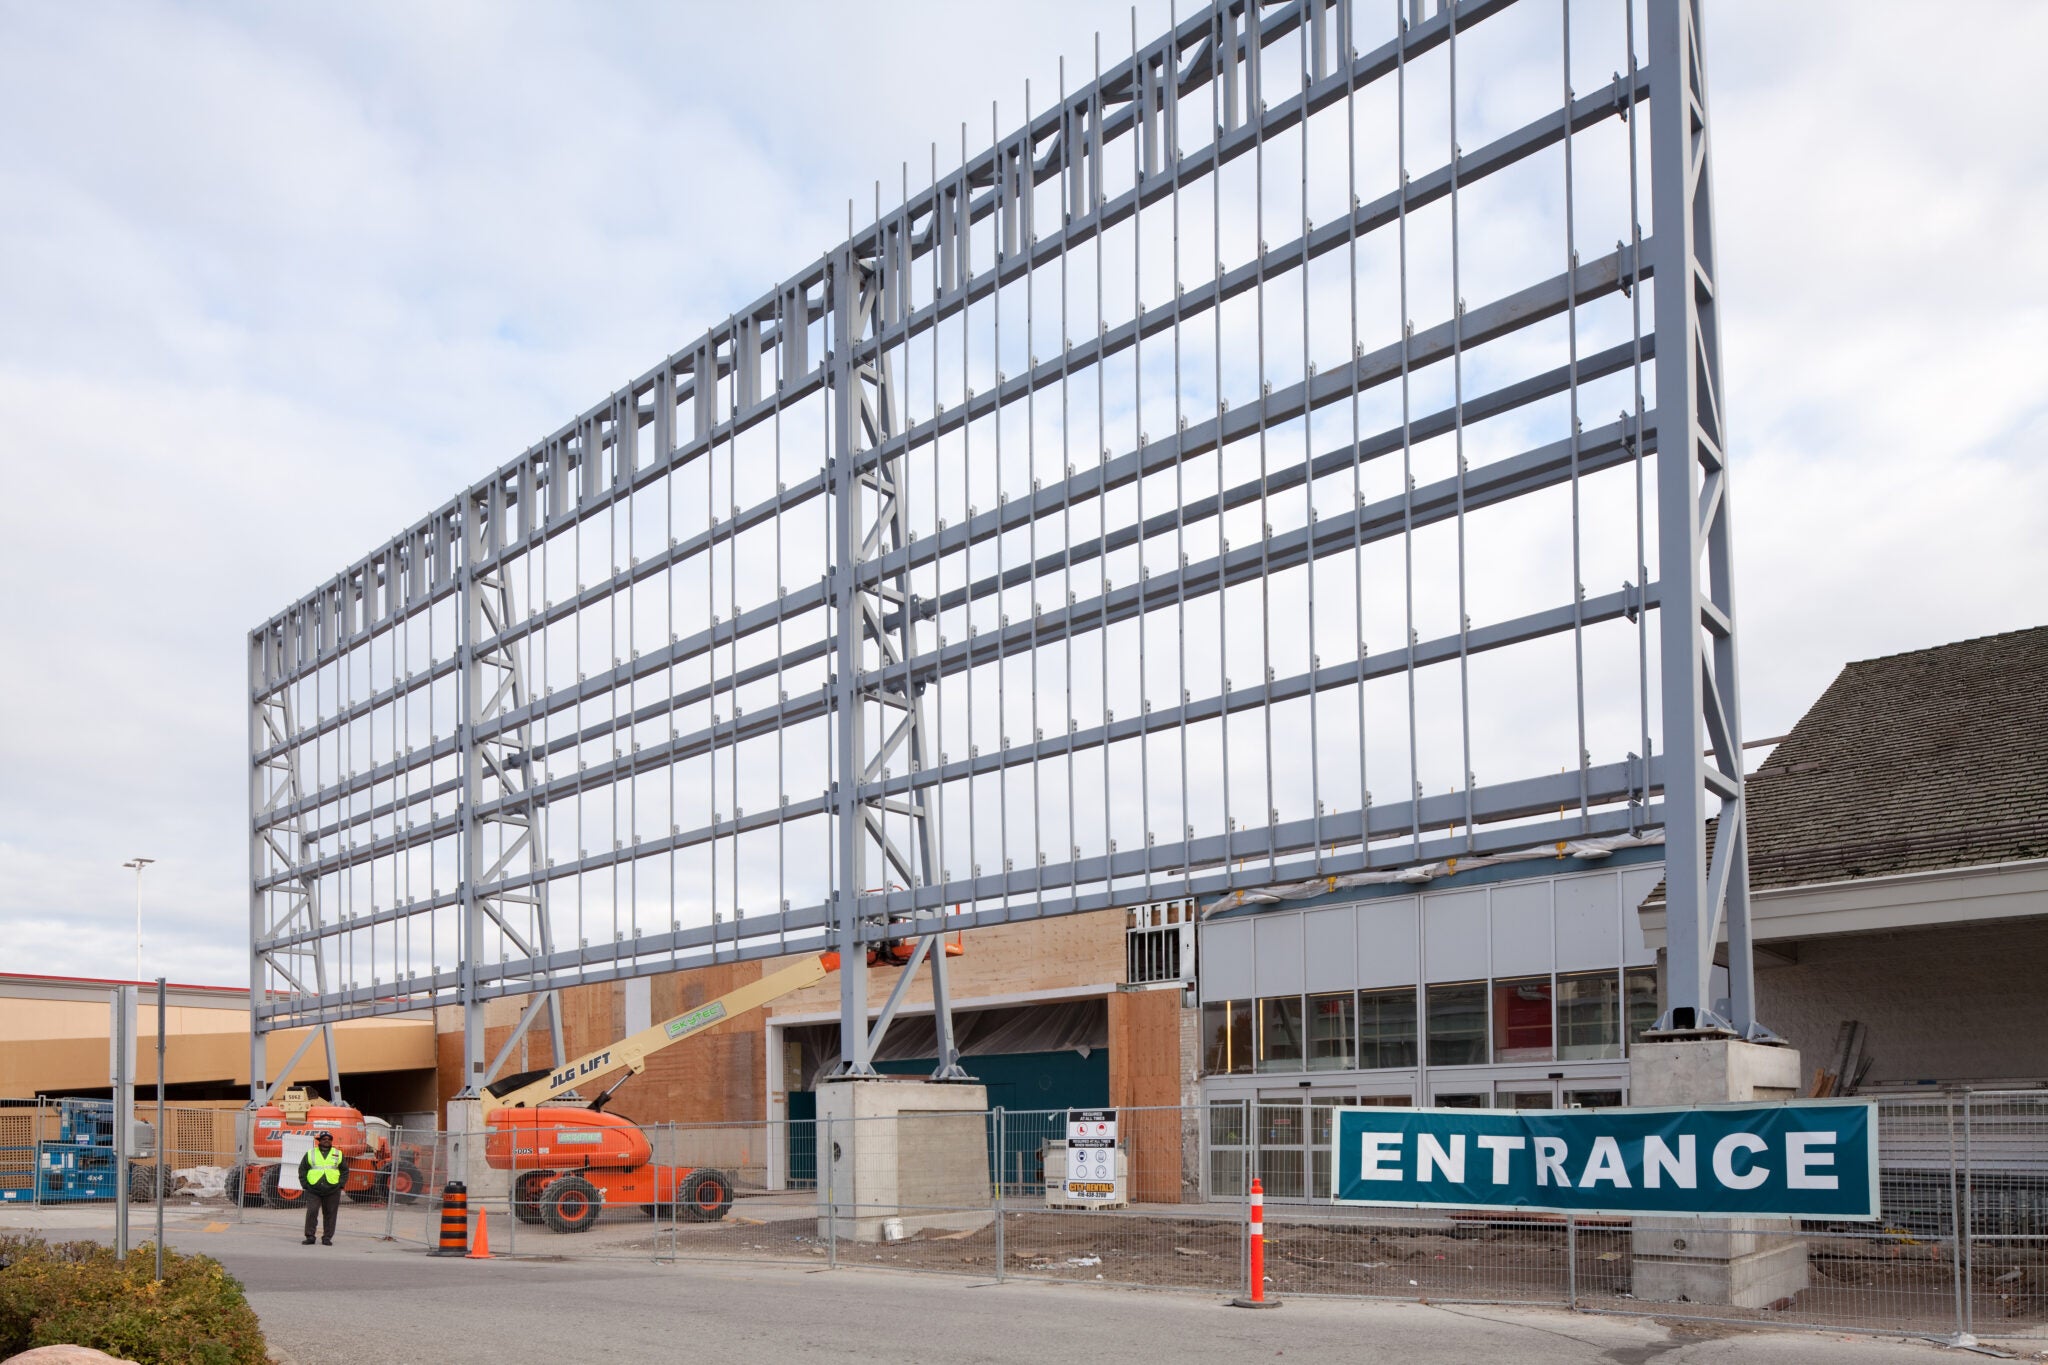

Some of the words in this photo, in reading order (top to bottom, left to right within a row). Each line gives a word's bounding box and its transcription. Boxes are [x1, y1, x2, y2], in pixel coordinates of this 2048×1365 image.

[550, 1068, 575, 1090] JLG
[580, 1051, 611, 1076] LIFT
[1360, 1131, 1839, 1190] ENTRANCE
[1069, 1182, 1084, 1192] CITY
[1086, 1182, 1114, 1192] RENTALS
